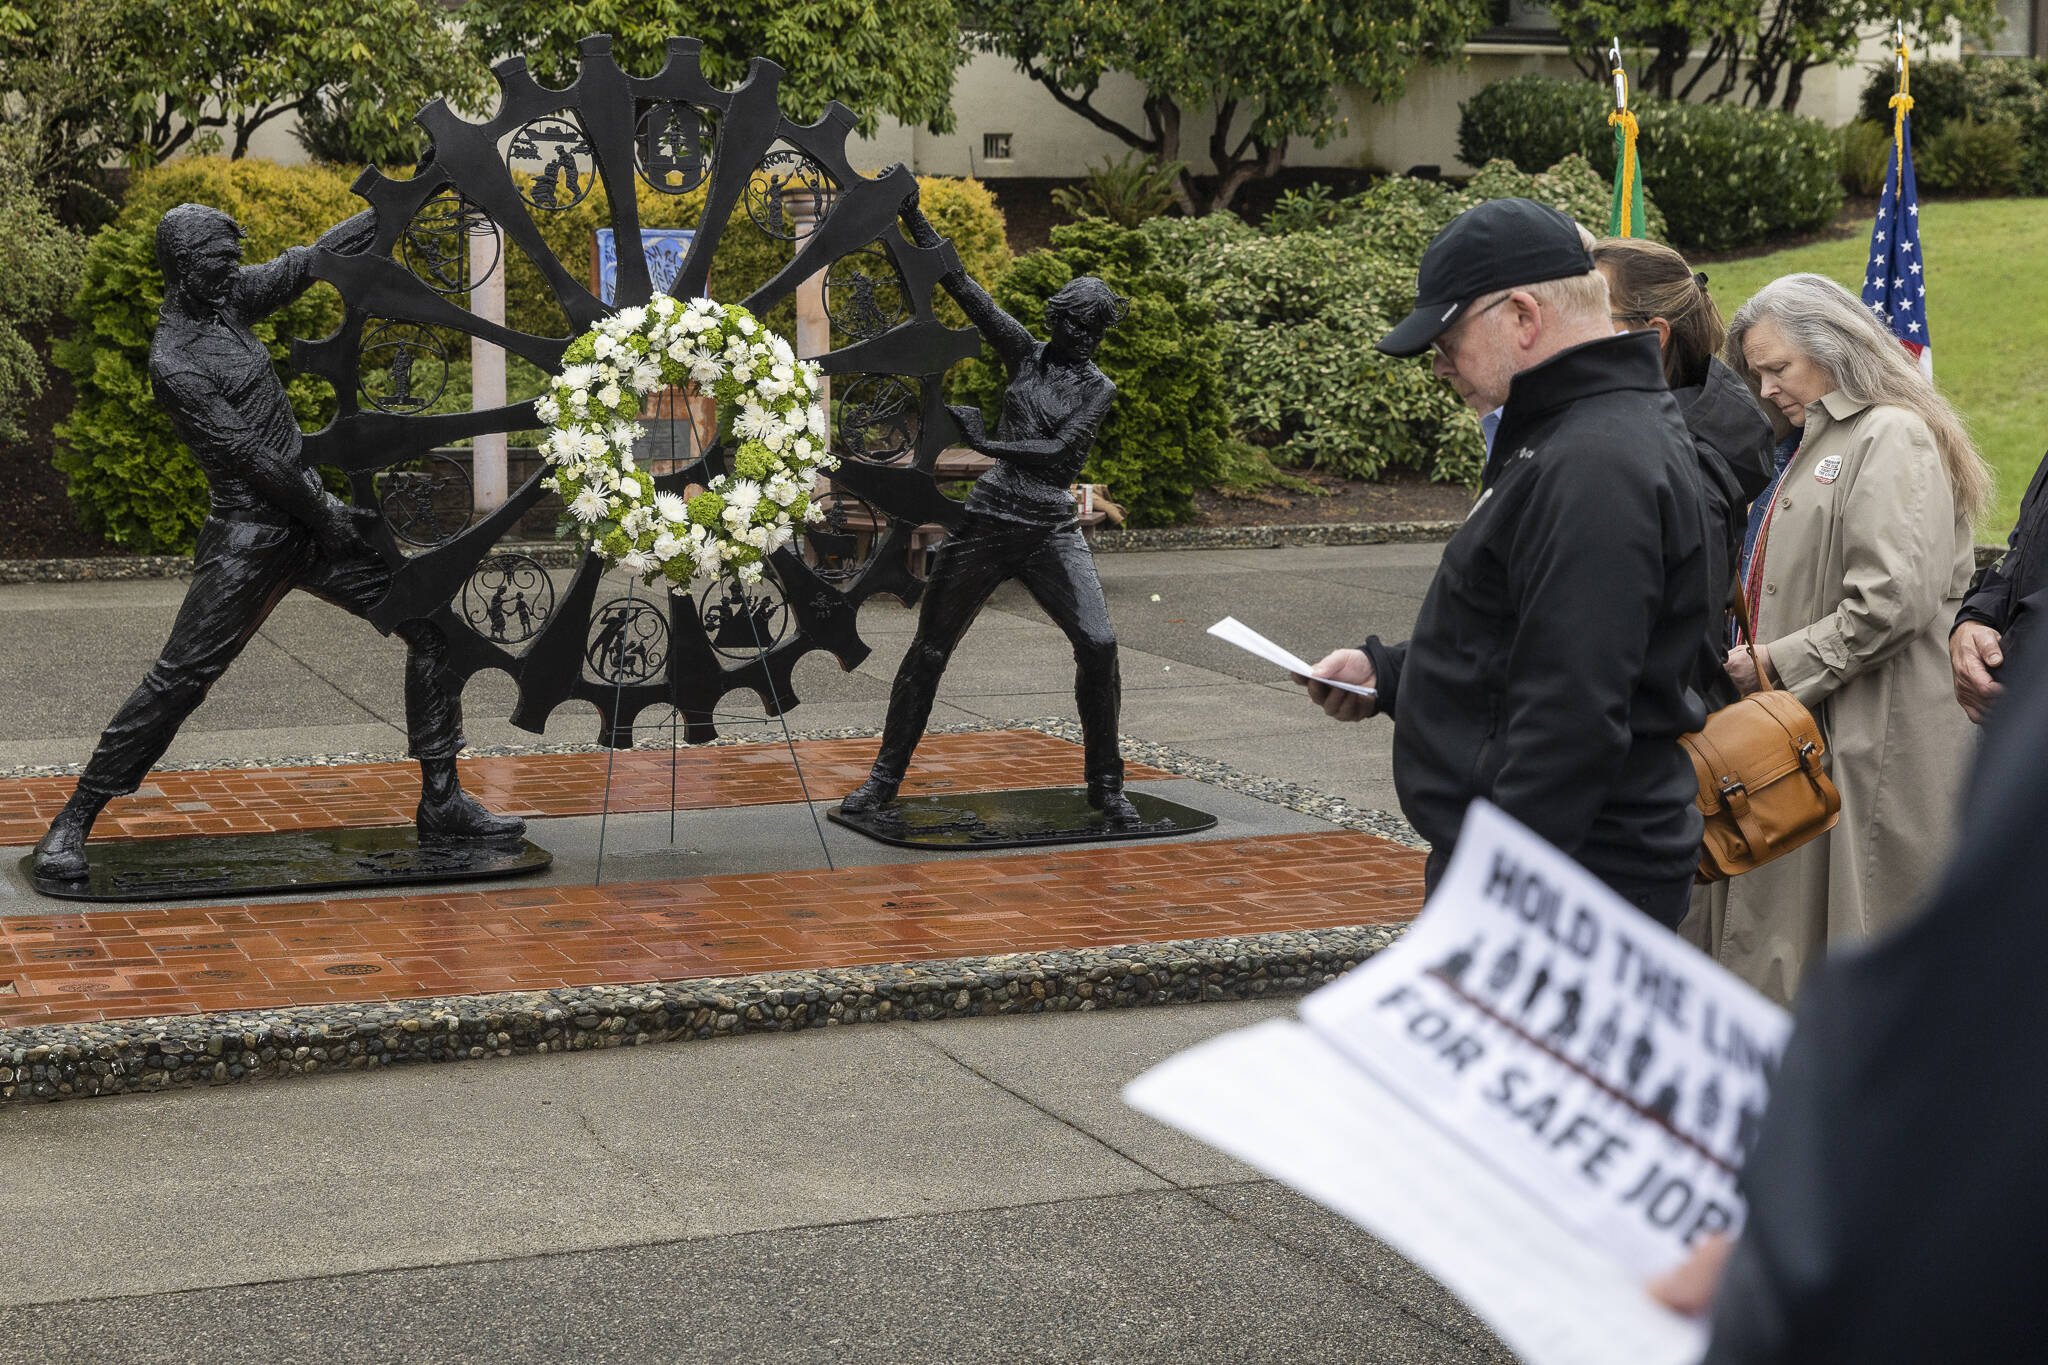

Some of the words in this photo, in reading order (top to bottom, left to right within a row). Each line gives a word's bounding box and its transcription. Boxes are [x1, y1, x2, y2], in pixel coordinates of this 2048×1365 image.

[1484, 850, 1601, 961] HOLD
[1614, 932, 1690, 1033] THE
[1377, 985, 1486, 1071] FOR
[1482, 1066, 1631, 1186] SAFE
